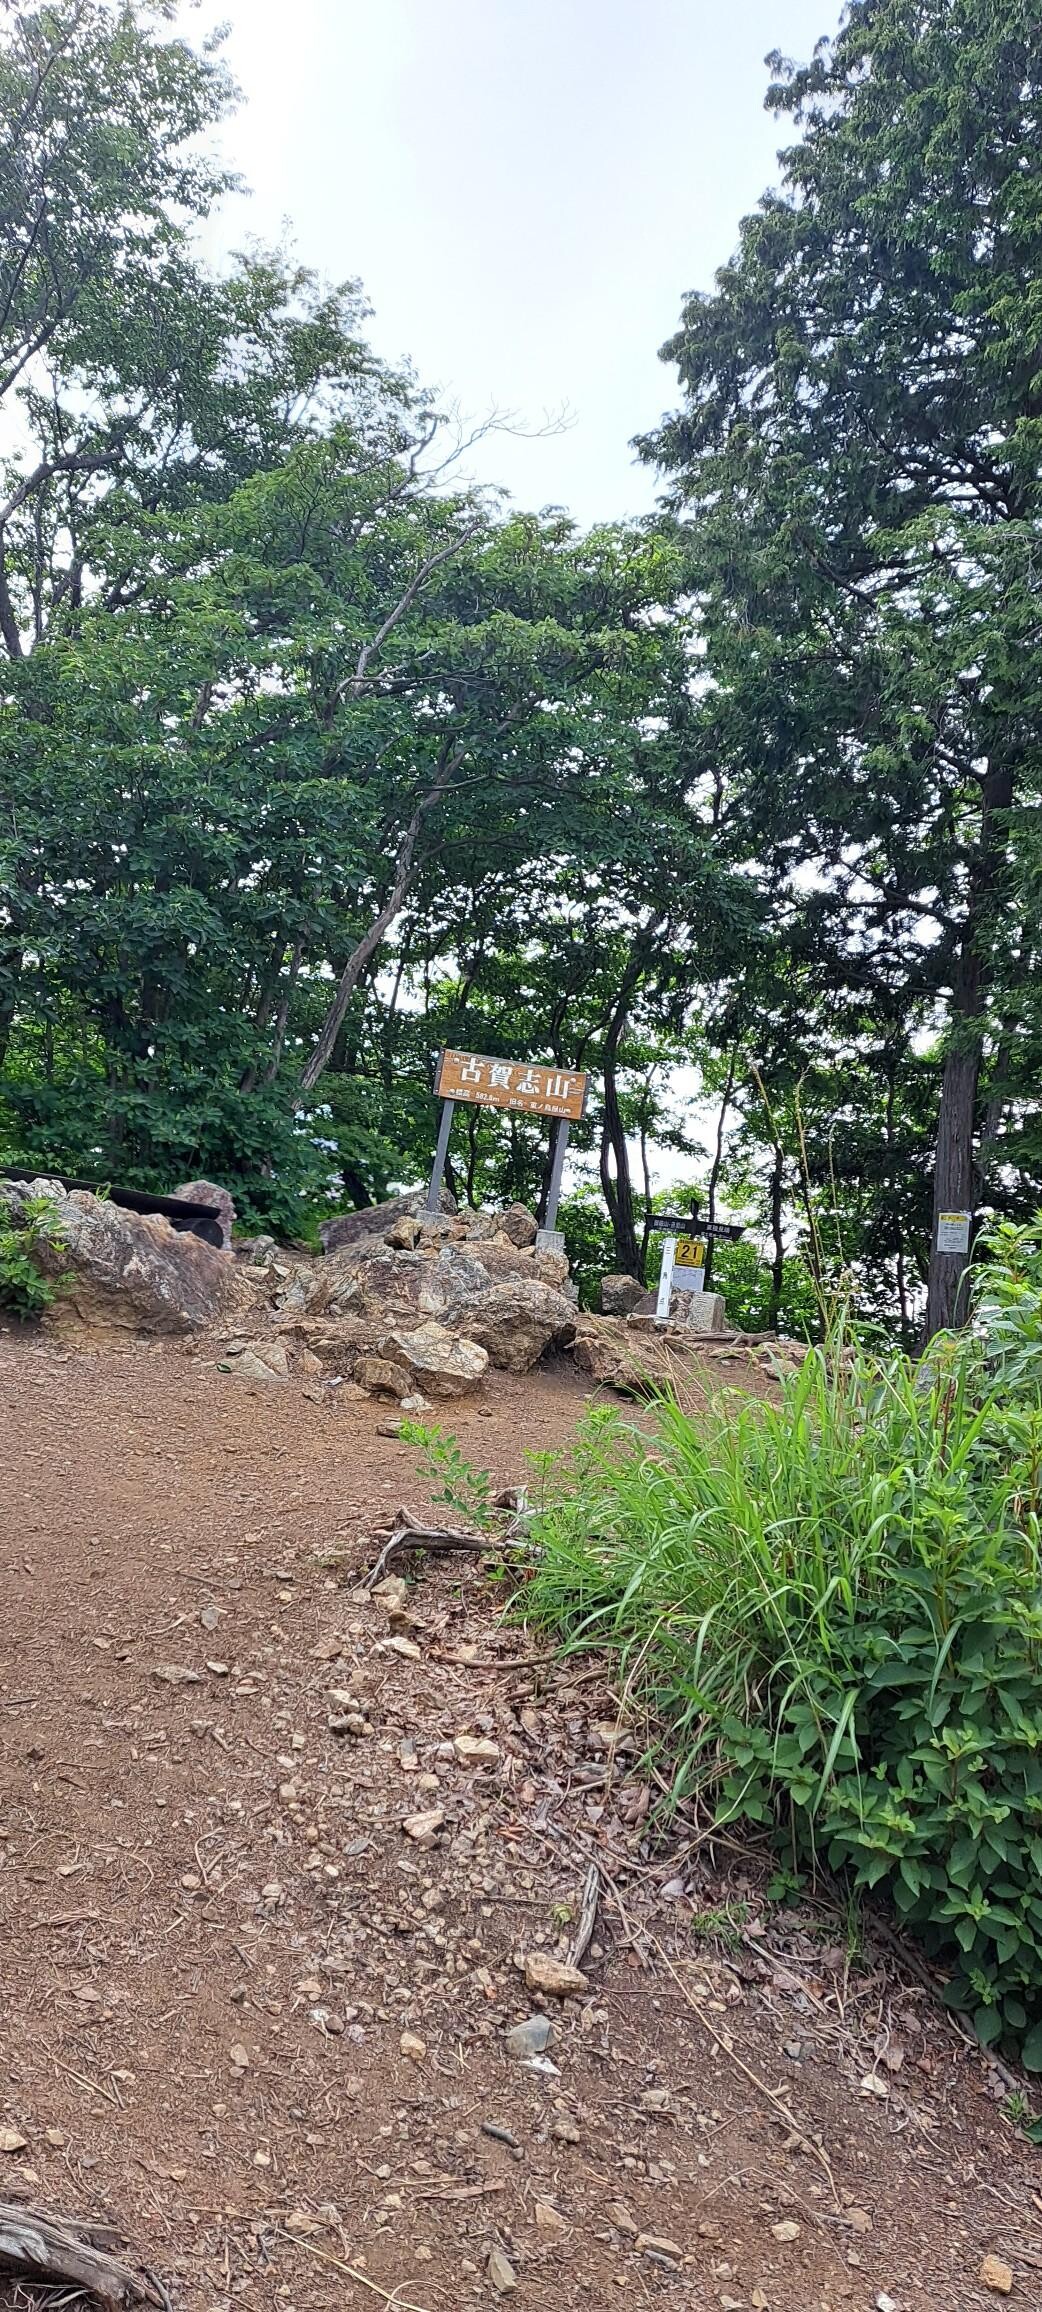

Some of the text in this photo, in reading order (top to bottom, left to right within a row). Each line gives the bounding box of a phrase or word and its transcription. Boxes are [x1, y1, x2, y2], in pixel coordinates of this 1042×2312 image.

[460, 1057, 570, 1100] 古賀志山
[681, 1244, 698, 1259] 21
